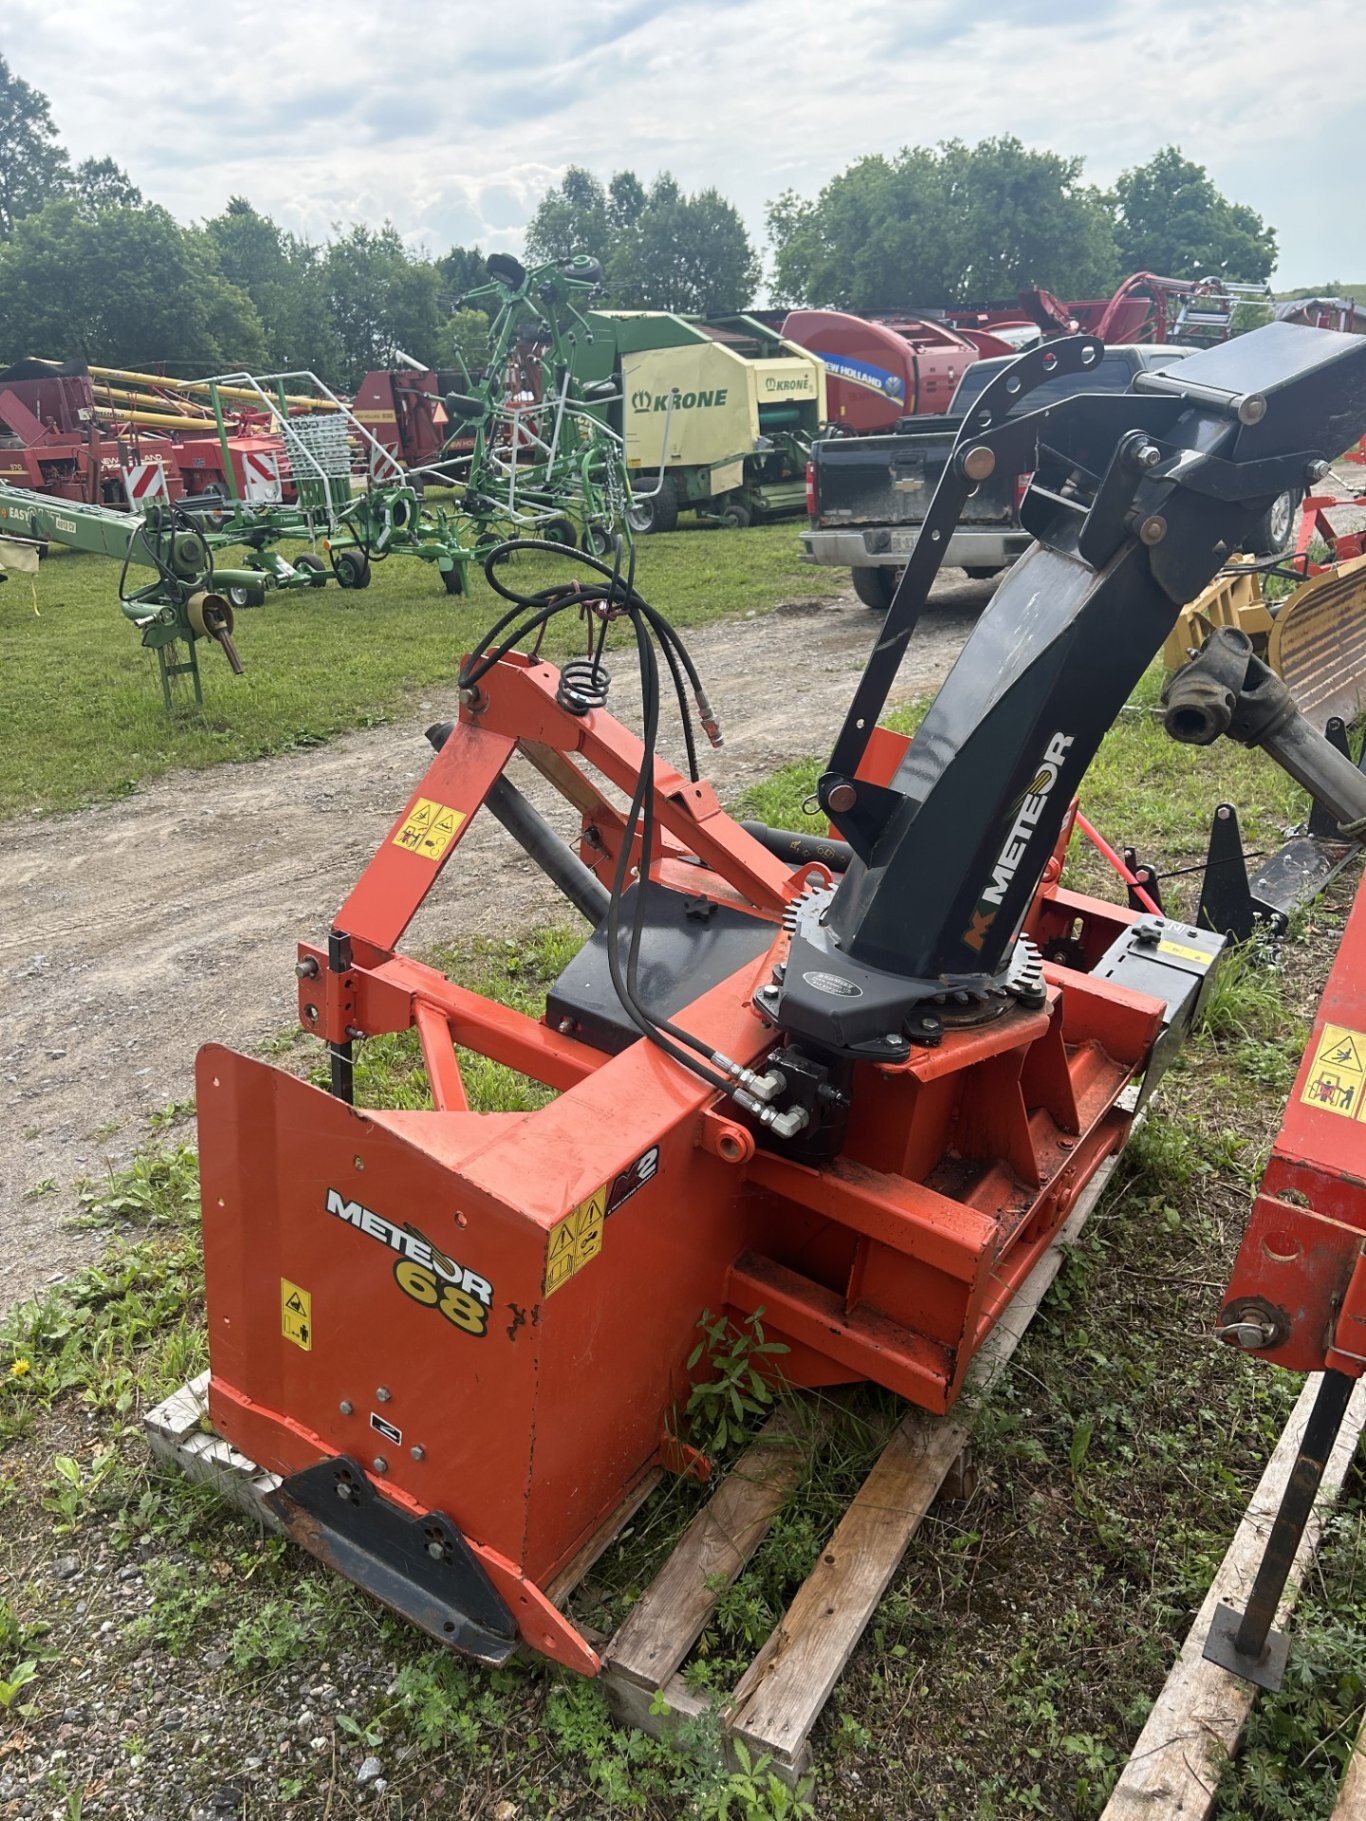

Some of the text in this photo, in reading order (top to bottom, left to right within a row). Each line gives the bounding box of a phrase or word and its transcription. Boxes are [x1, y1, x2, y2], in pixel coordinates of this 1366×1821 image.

[653, 389, 728, 412] KRONE
[776, 379, 809, 391] KRONE
[840, 364, 882, 388] HOLLAND
[982, 731, 1075, 906] METEOR
[326, 1189, 493, 1305] METEOR
[394, 1258, 488, 1336] 68
